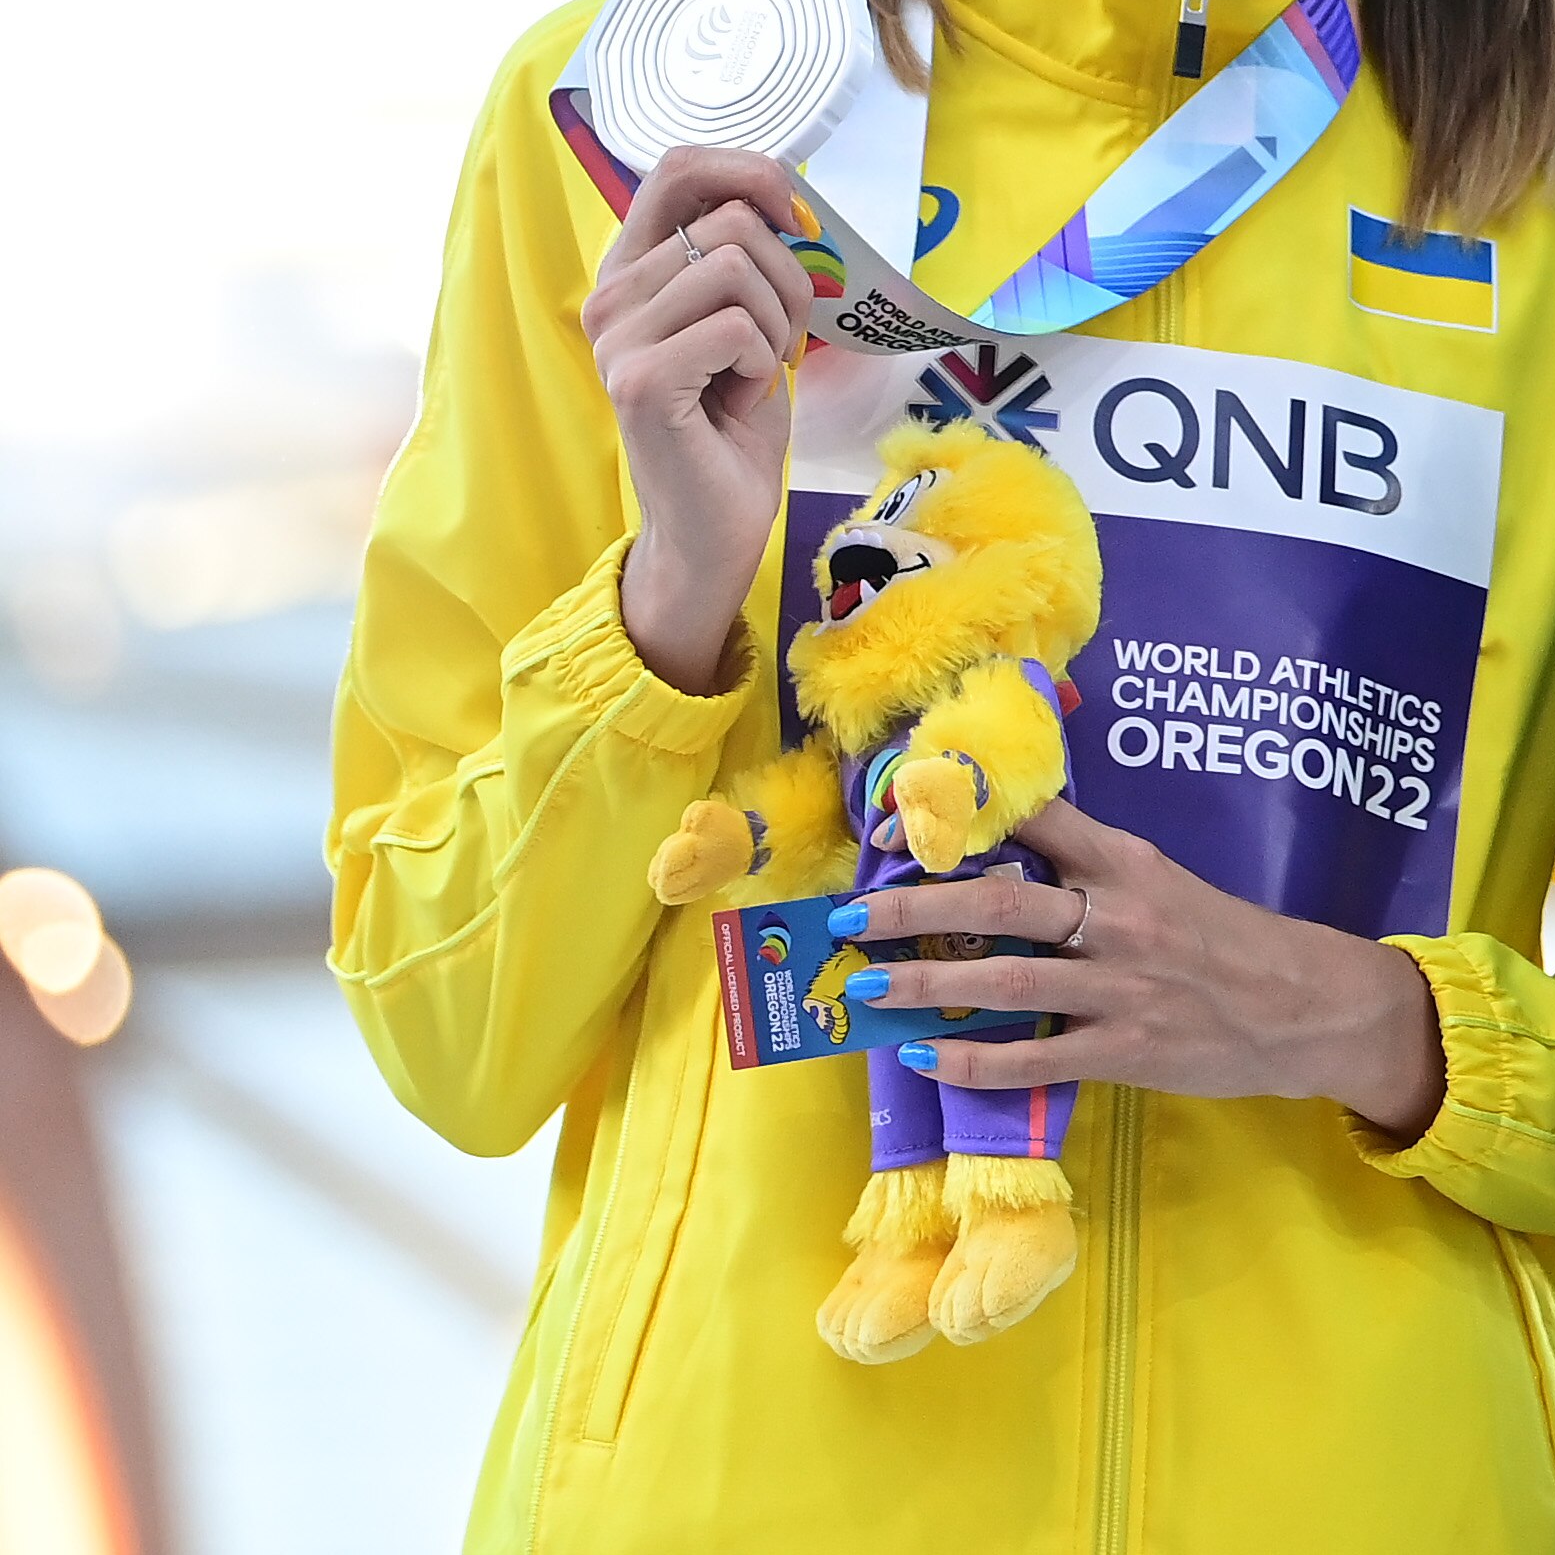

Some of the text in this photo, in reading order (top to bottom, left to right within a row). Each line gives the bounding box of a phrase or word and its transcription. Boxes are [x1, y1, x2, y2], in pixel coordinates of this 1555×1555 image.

[866, 288, 926, 330] WORLD
[1093, 377, 1402, 515] QNB
[1111, 675, 1436, 773] CHAMPIONSHIPS
[1113, 638, 1442, 734] WORLD ATHLETICS
[721, 923, 734, 966] OFFICIAL
[732, 1012, 746, 1057] PRODUCT
